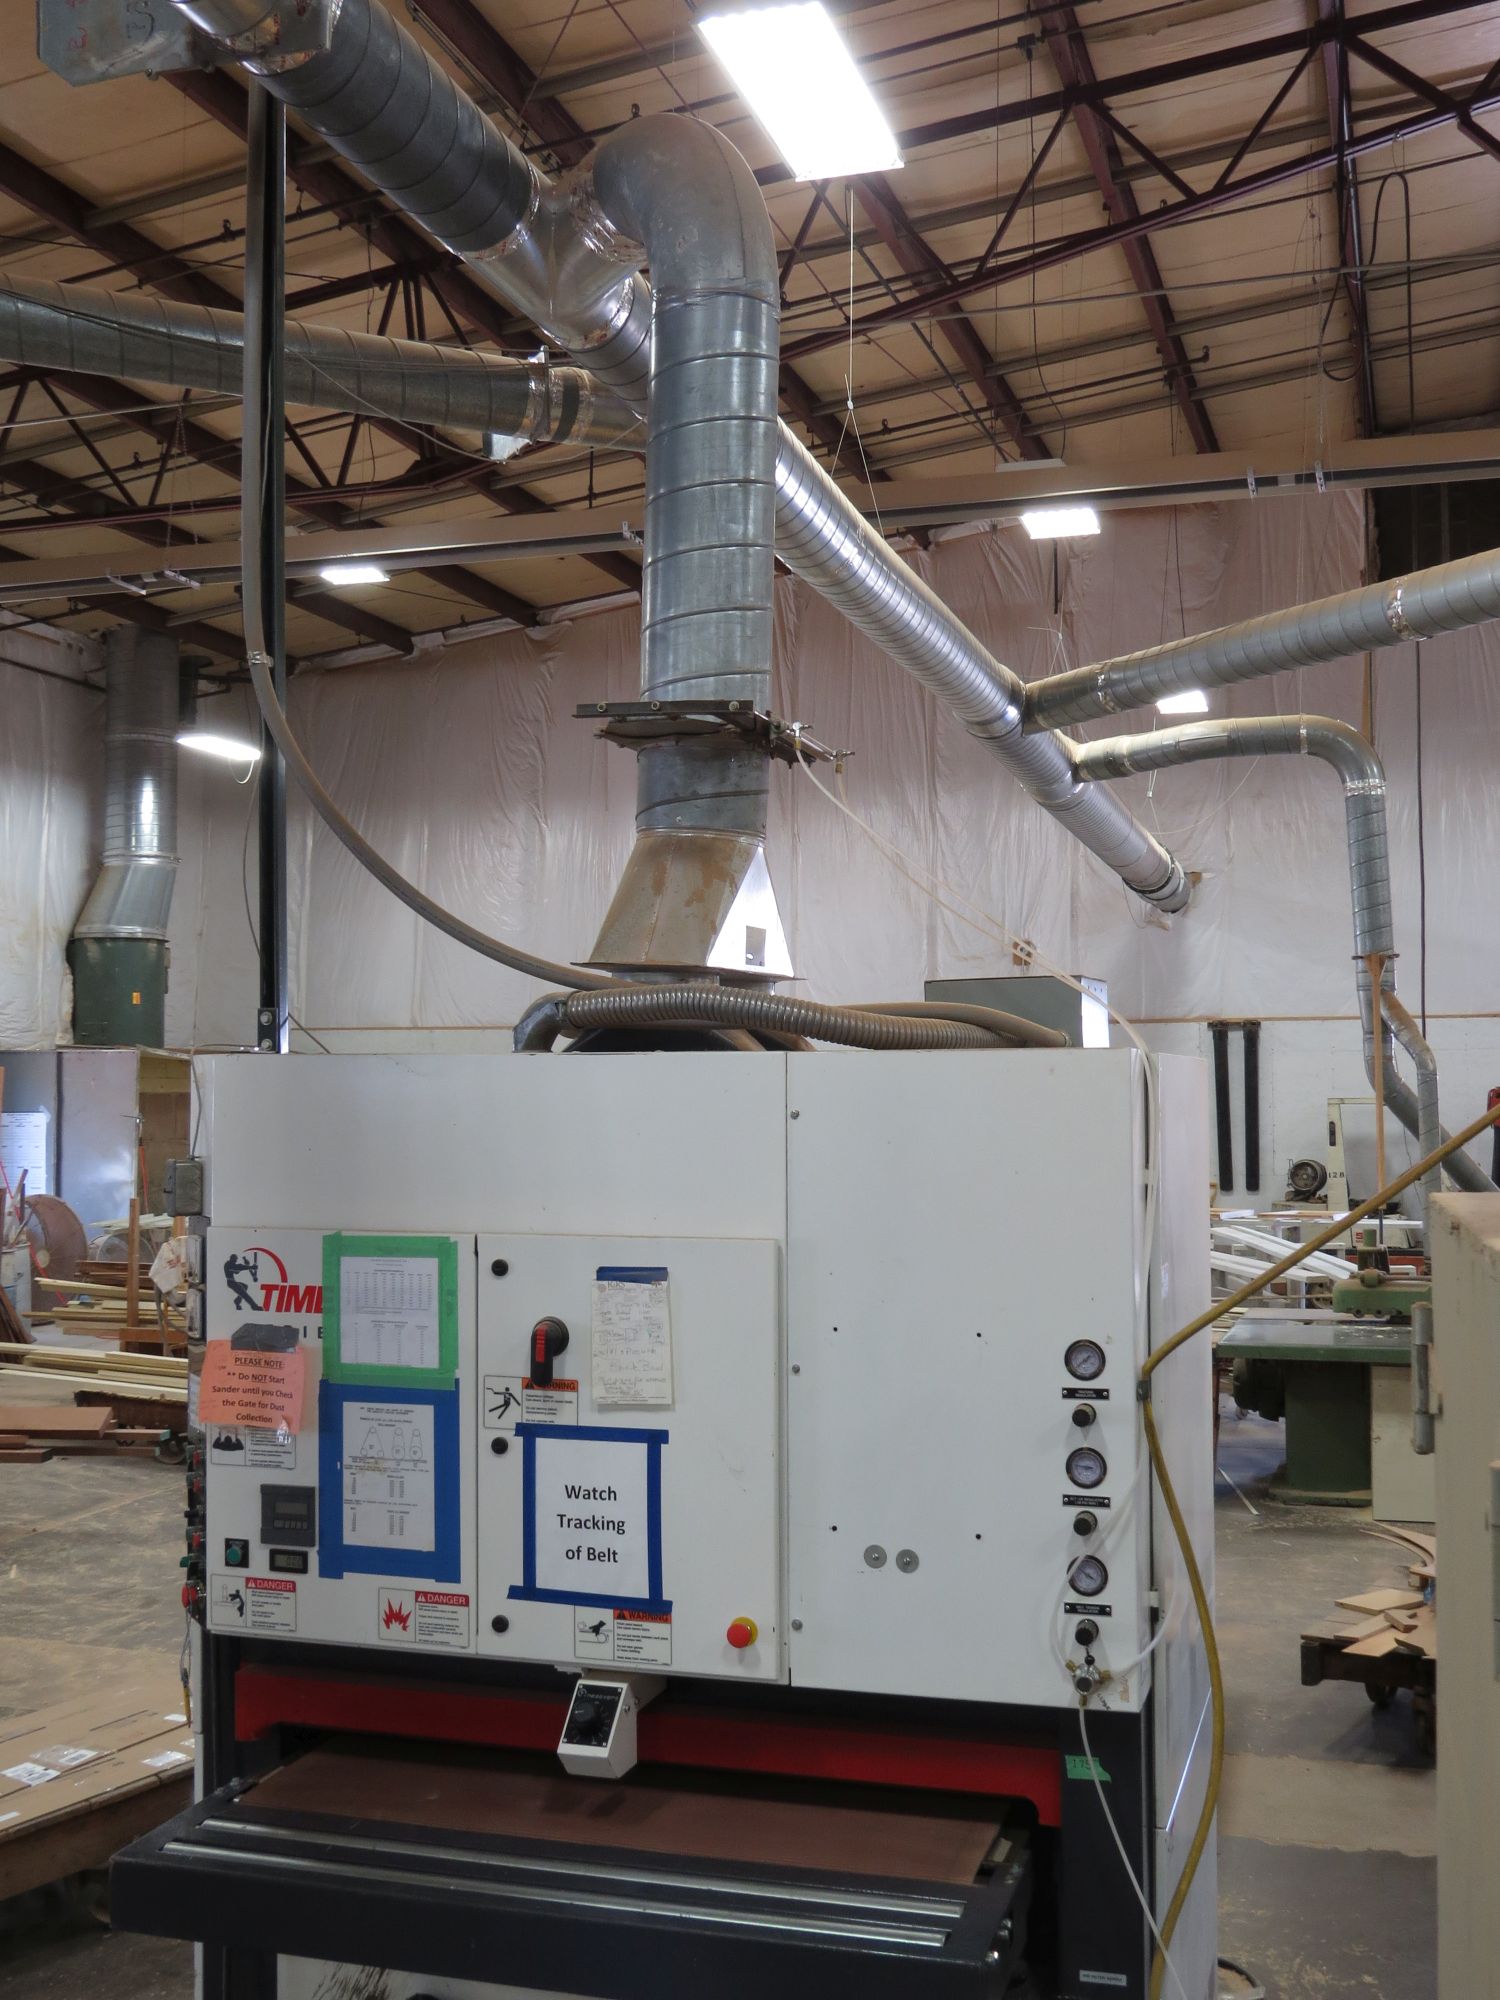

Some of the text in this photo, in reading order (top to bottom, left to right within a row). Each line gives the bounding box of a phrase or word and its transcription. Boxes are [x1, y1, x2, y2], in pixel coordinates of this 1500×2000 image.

[234, 1357, 262, 1367] PLEASE
[238, 1372, 250, 1380] Do
[251, 1373, 268, 1382] NOT
[268, 1375, 285, 1384] Start
[212, 1385, 293, 1399] Sander until you Check
[238, 1400, 257, 1408] Gate
[258, 1401, 269, 1409] for
[269, 1402, 285, 1411] Dust
[236, 1413, 273, 1423] Collection
[564, 1484, 617, 1501] Watch
[556, 1513, 626, 1535] Tracking
[565, 1545, 619, 1563] of Belt
[256, 1580, 294, 1591] DANGER
[427, 1594, 466, 1605] DANGER
